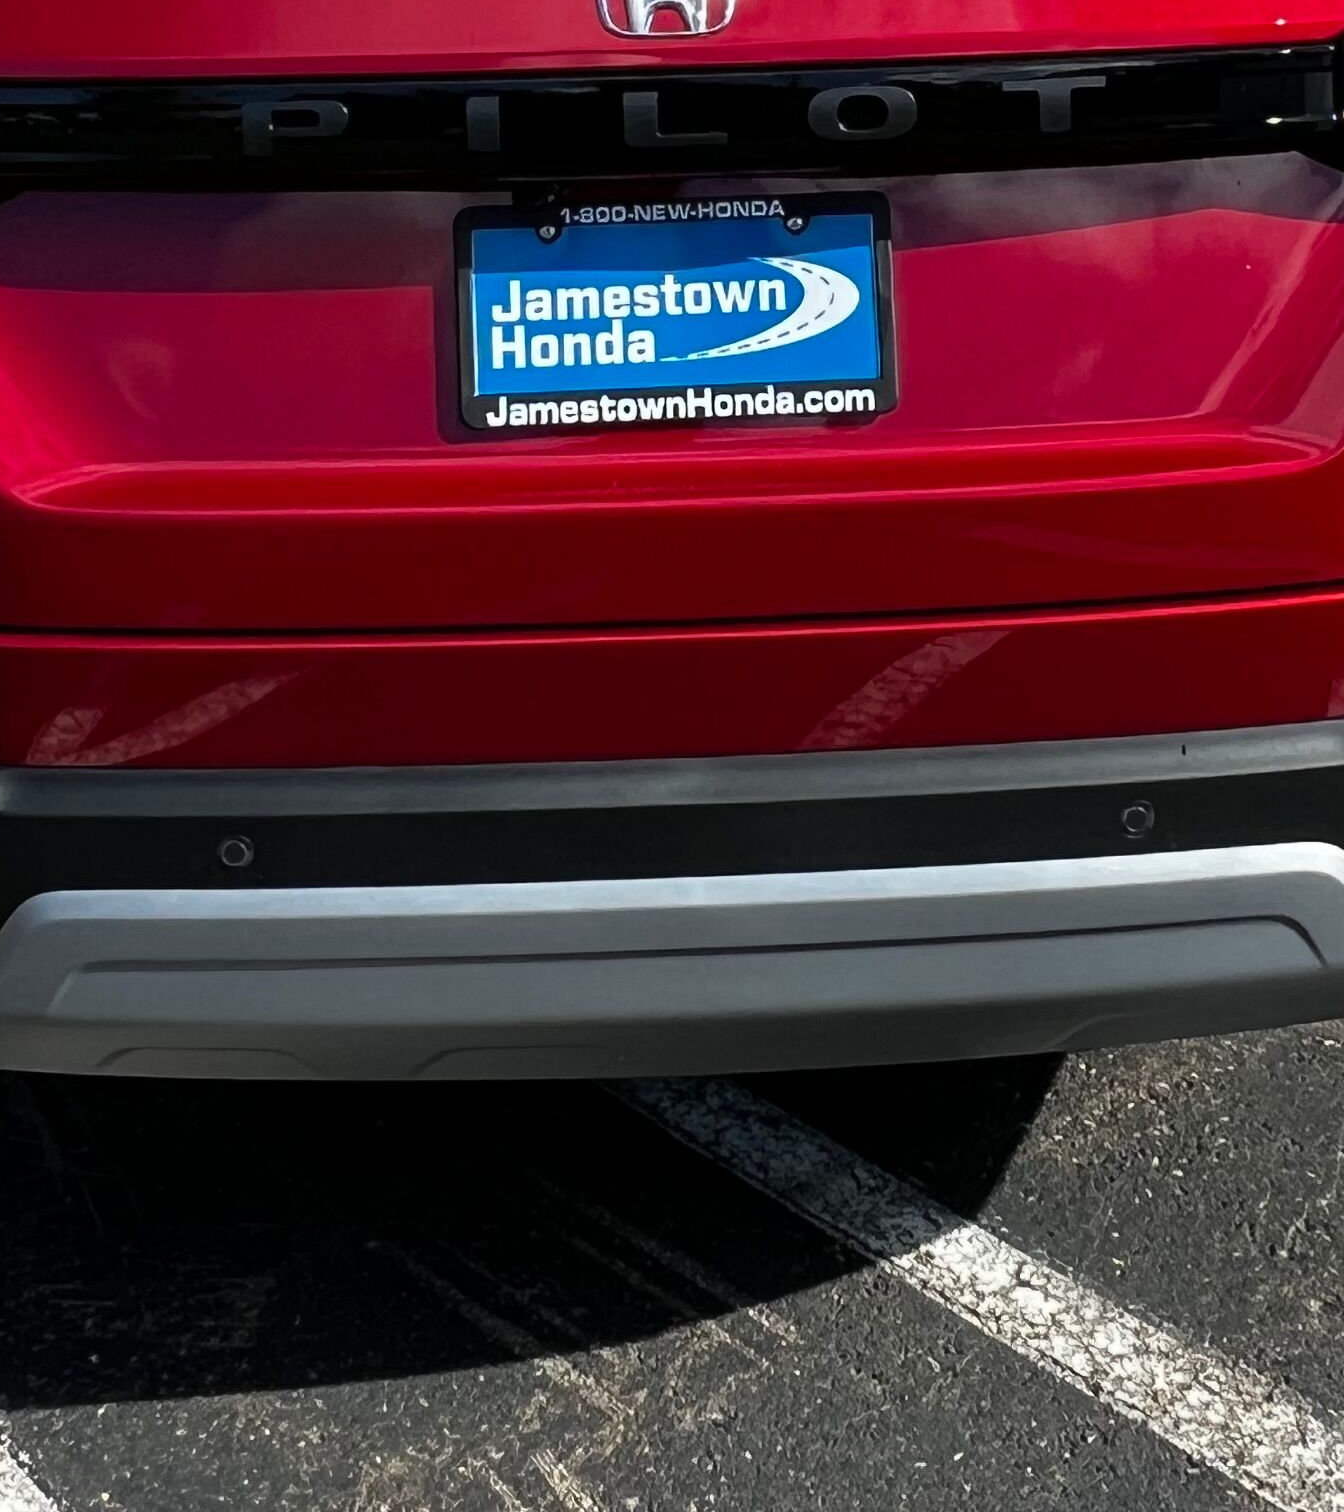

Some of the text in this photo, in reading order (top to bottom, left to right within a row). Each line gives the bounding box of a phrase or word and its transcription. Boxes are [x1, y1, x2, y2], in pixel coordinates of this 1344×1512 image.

[239, 75, 1108, 157] PILOT
[559, 199, 786, 226] 1-800-NEW-HONDA
[491, 274, 786, 324] Jamestown
[491, 319, 656, 369] Honda
[485, 384, 876, 427] JamestownHonda.com
